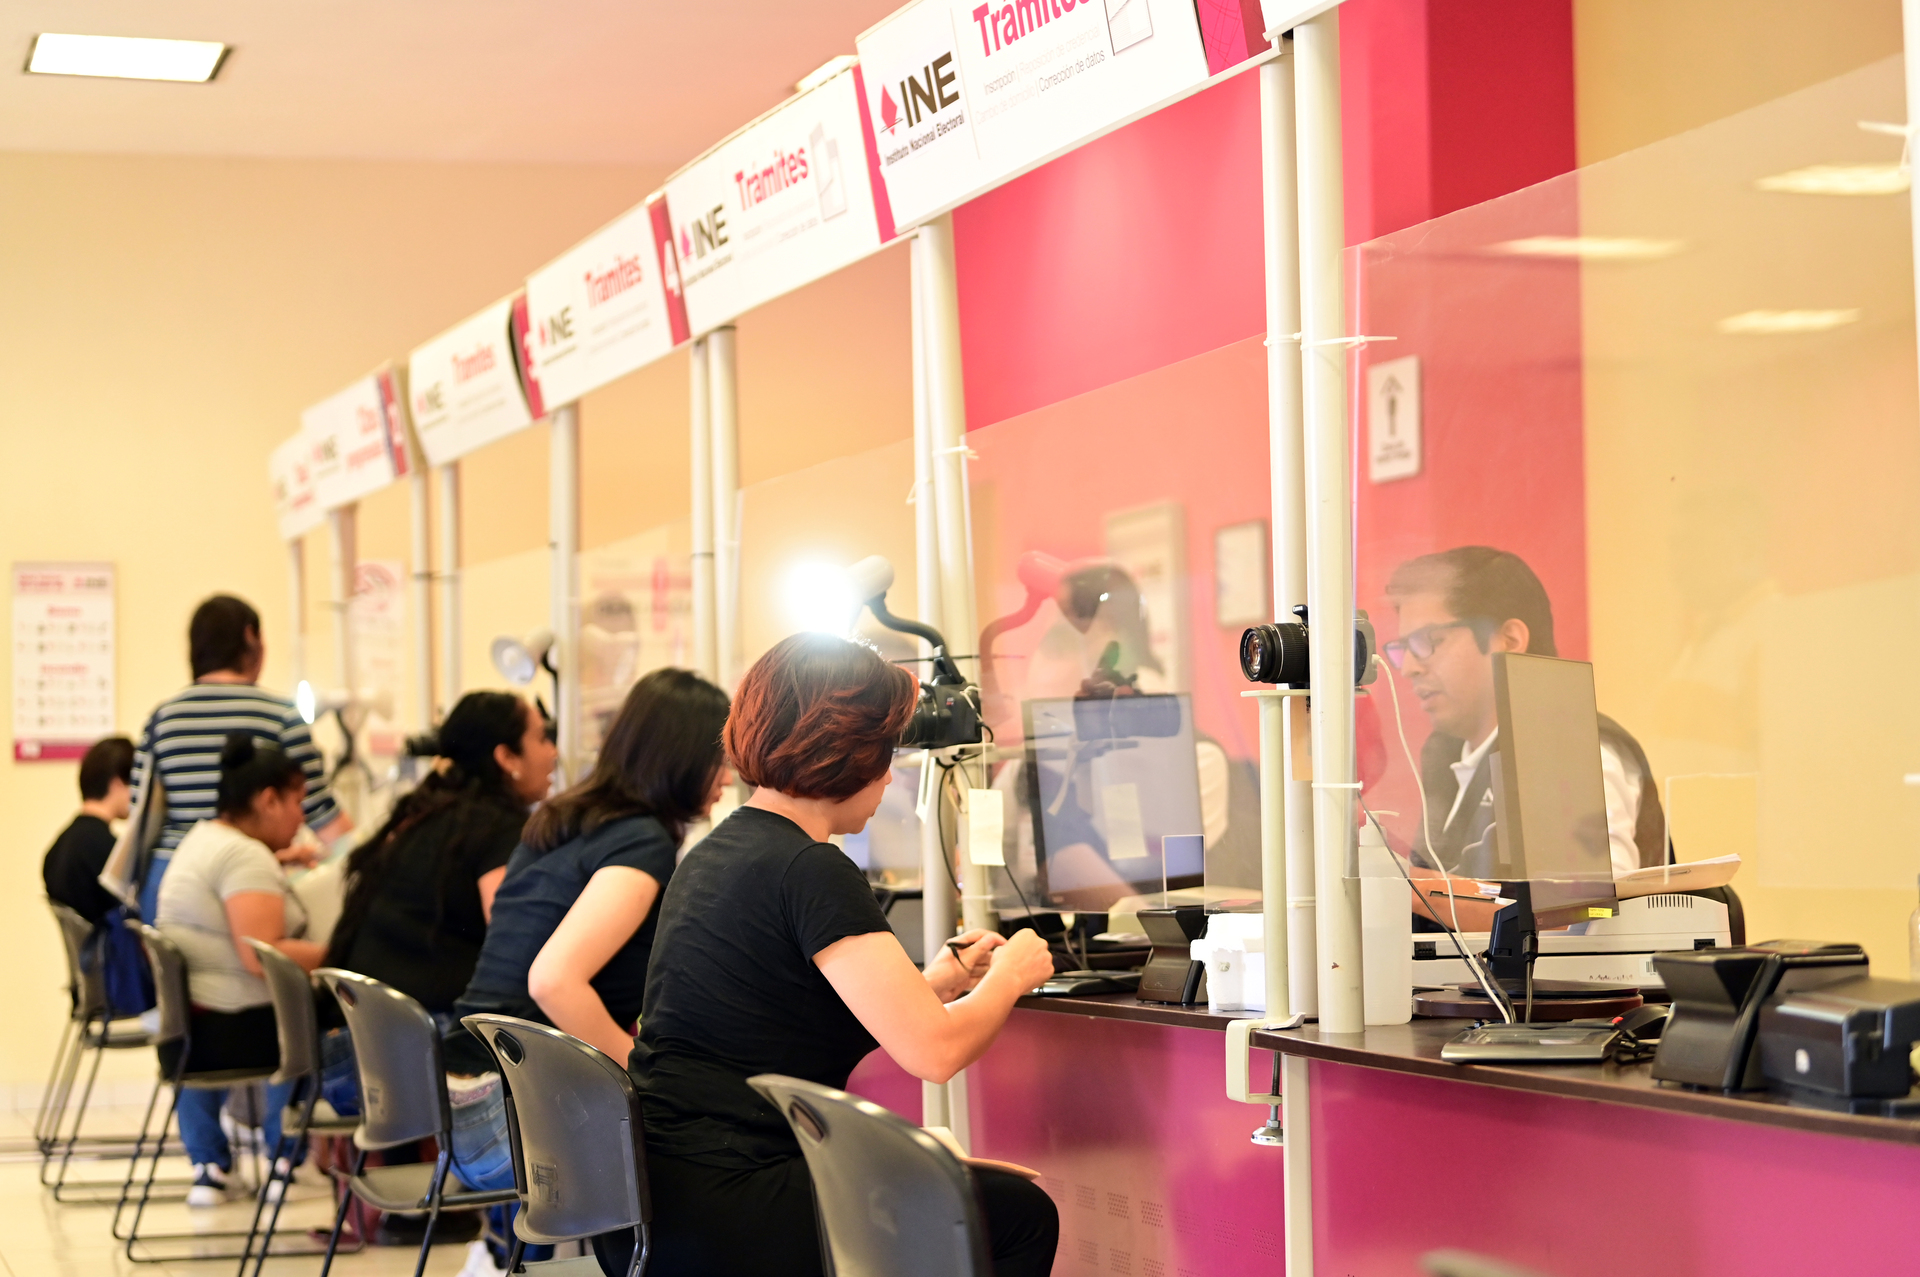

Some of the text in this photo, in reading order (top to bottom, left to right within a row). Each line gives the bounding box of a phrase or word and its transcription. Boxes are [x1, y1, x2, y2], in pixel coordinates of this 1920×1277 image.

[972, 0, 1090, 57] Trámi
[983, 22, 1101, 96] Inscripción Reposición de credencial
[1038, 64, 1076, 92] Corrección
[1075, 59, 1085, 74] de
[1085, 50, 1106, 69] datos
[900, 51, 960, 128] INE
[885, 109, 965, 167] Instituto Nacional Electoral
[735, 148, 808, 210] Trámites
[691, 203, 730, 260] INE
